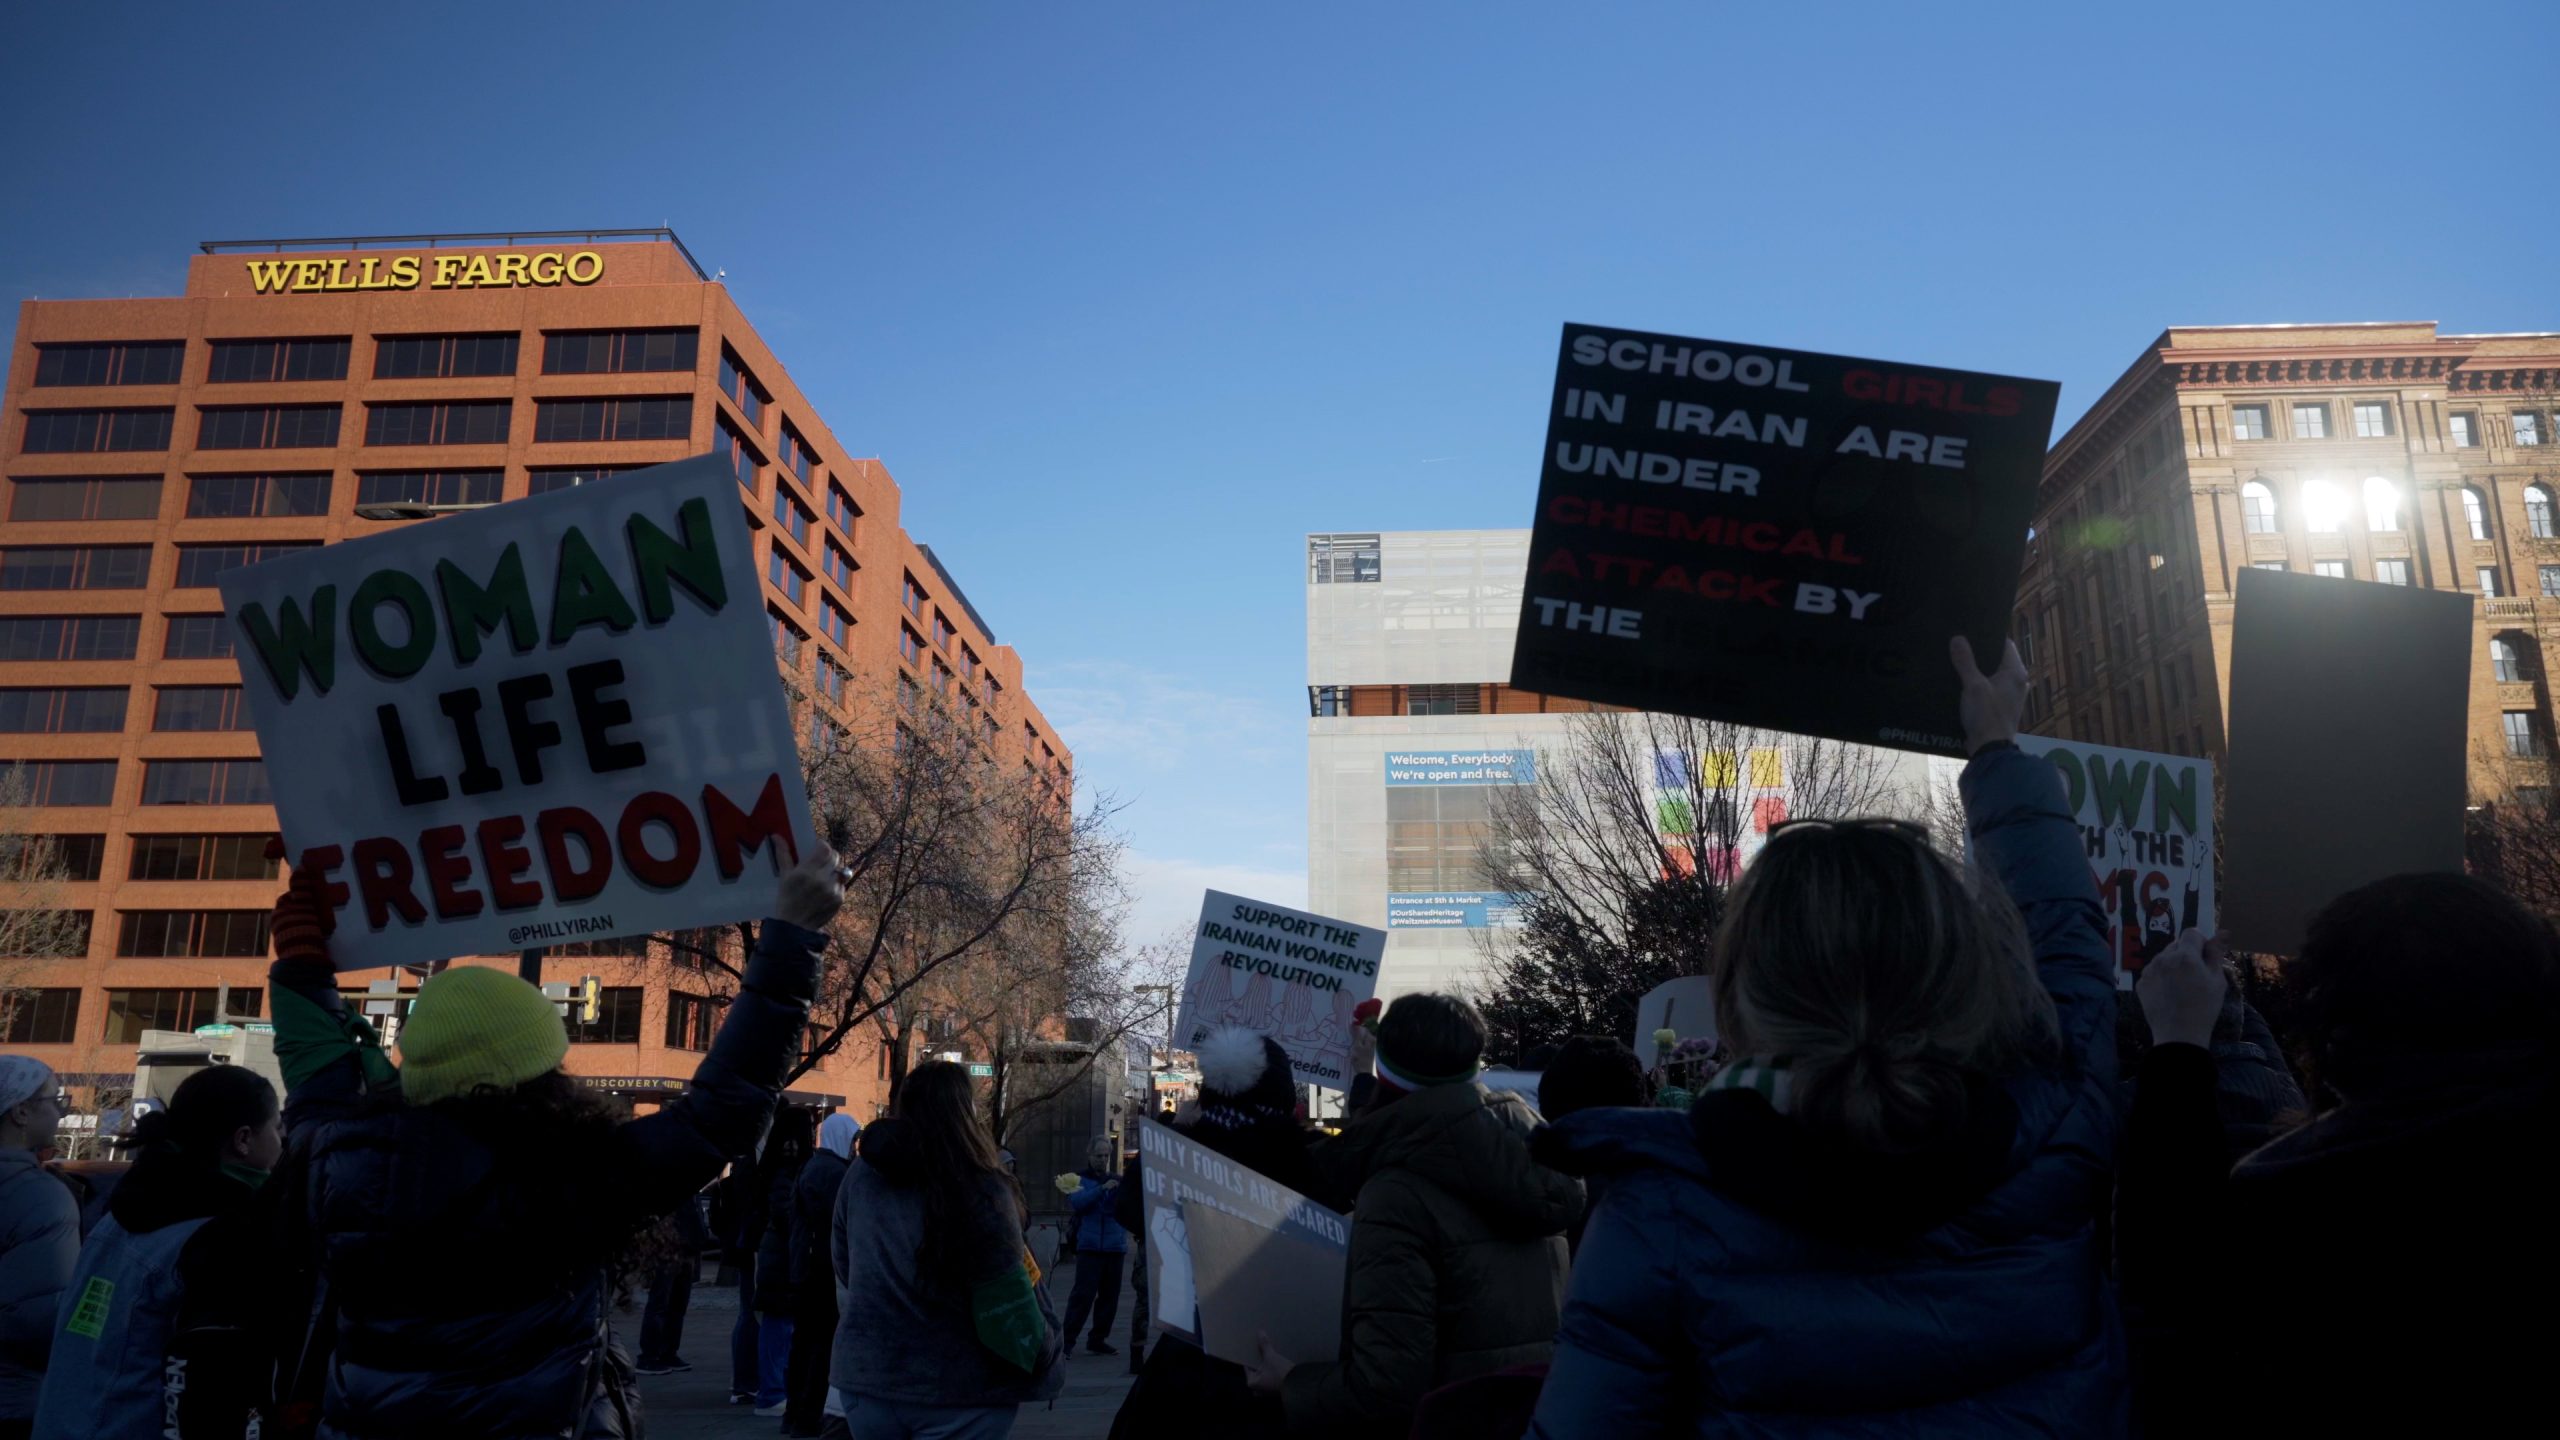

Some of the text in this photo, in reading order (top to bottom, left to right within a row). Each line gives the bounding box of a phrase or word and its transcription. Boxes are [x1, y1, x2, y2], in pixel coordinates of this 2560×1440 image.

[247, 251, 604, 293] WELLS FARGO
[1571, 334, 2024, 418] SCHOOL GIRLS
[1563, 388, 1969, 470] IN IRAN ARE
[1555, 441, 1761, 497] UNDER
[1548, 494, 1865, 566] CHEMICAL
[237, 496, 729, 701] WOMAN
[1540, 546, 1882, 620] ATTACK BY
[1533, 596, 1643, 640] THE
[377, 658, 646, 806] LIFE
[1879, 727, 1962, 749] @PHILLYIRA
[1391, 753, 1516, 766] Welcome, Everybody.
[1391, 768, 1513, 781] We're open and free.
[301, 772, 799, 929] FREEDOM
[2131, 830, 2184, 867] THE
[1390, 897, 1423, 905] Entrance
[1456, 896, 1482, 904] Market
[508, 914, 614, 945] @PHILLYIRAN
[1232, 904, 1360, 948] SUPPORT THE
[1202, 921, 1377, 977] IRANIAN WOMEN'S
[1220, 950, 1342, 993] REVOLUTION
[586, 1079, 660, 1088] DISCOVERY
[1142, 1126, 1186, 1168] ONLY
[1193, 1150, 1243, 1197] FOOLS
[1251, 1178, 1281, 1214] ARE
[1284, 1197, 1345, 1246] SCARED
[1144, 1167, 1166, 1197] OF
